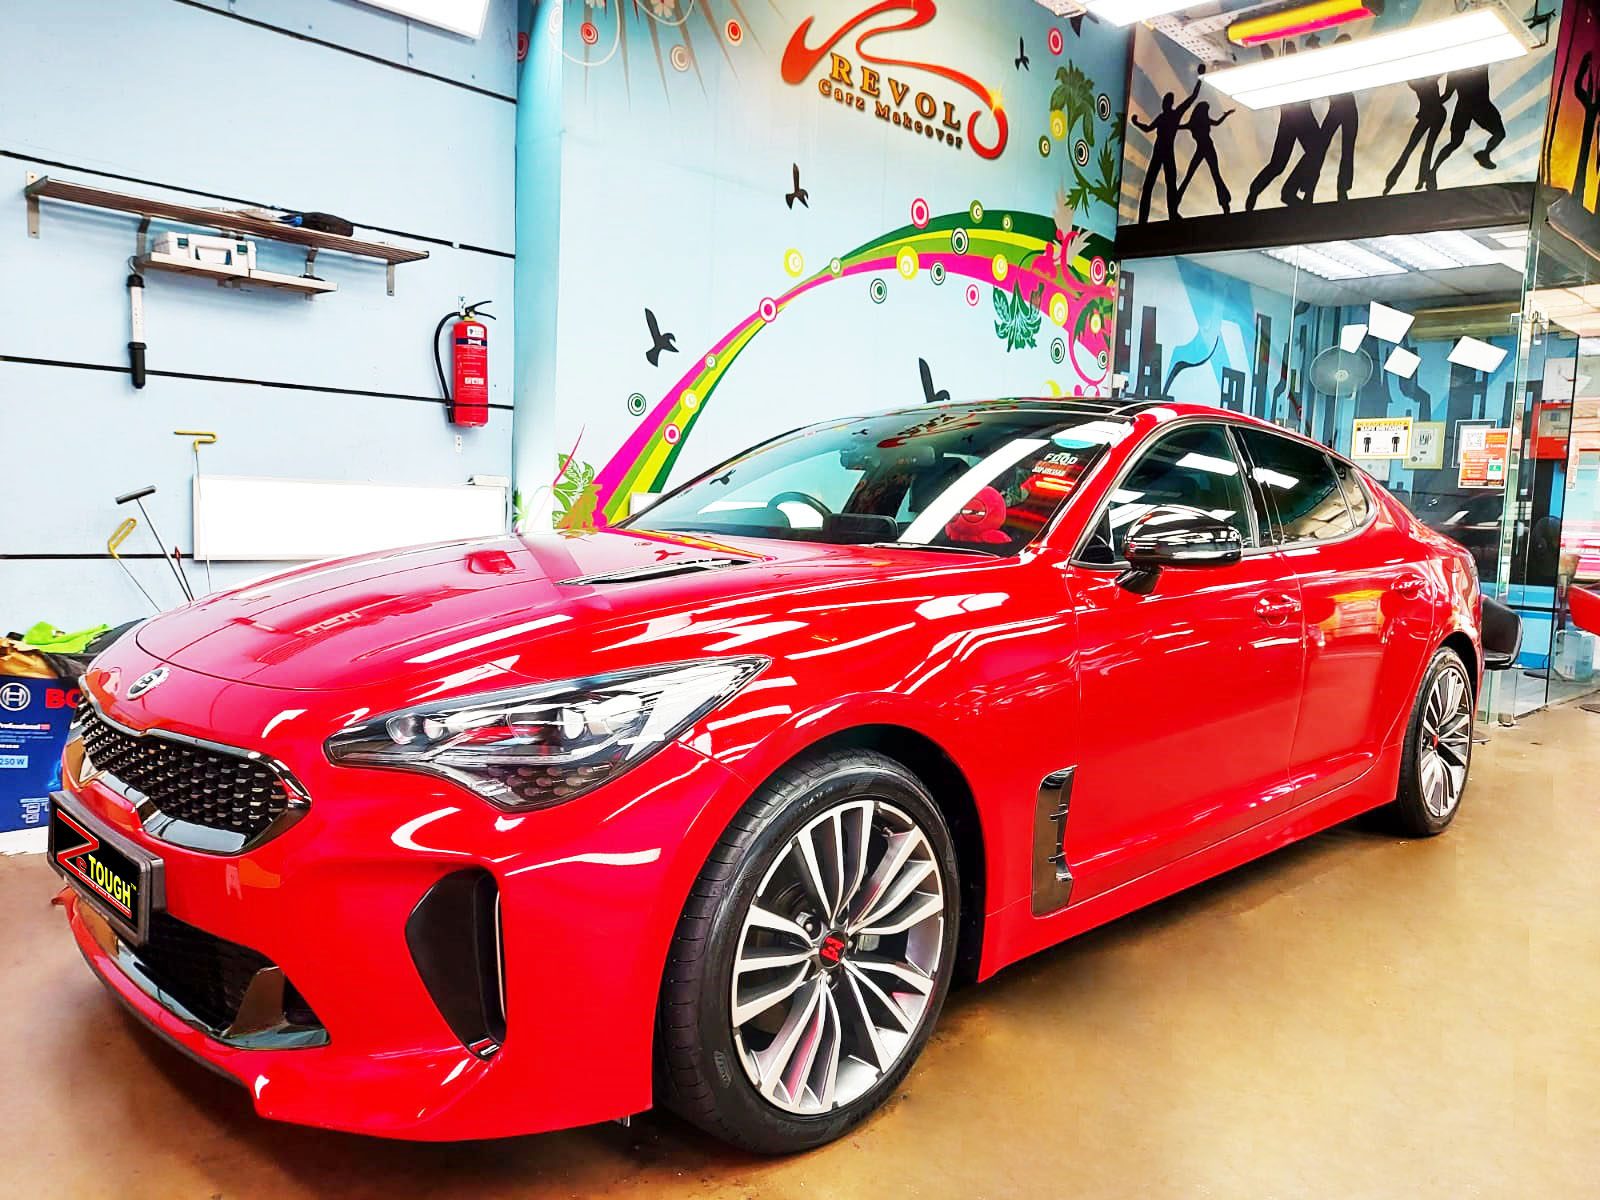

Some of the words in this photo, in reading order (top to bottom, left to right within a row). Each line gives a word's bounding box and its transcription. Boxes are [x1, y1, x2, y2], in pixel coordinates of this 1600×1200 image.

[818, 78, 866, 111] Carz
[875, 101, 963, 150] Makeover
[830, 52, 961, 131] REVOL
[88, 853, 131, 909] TOUGH
